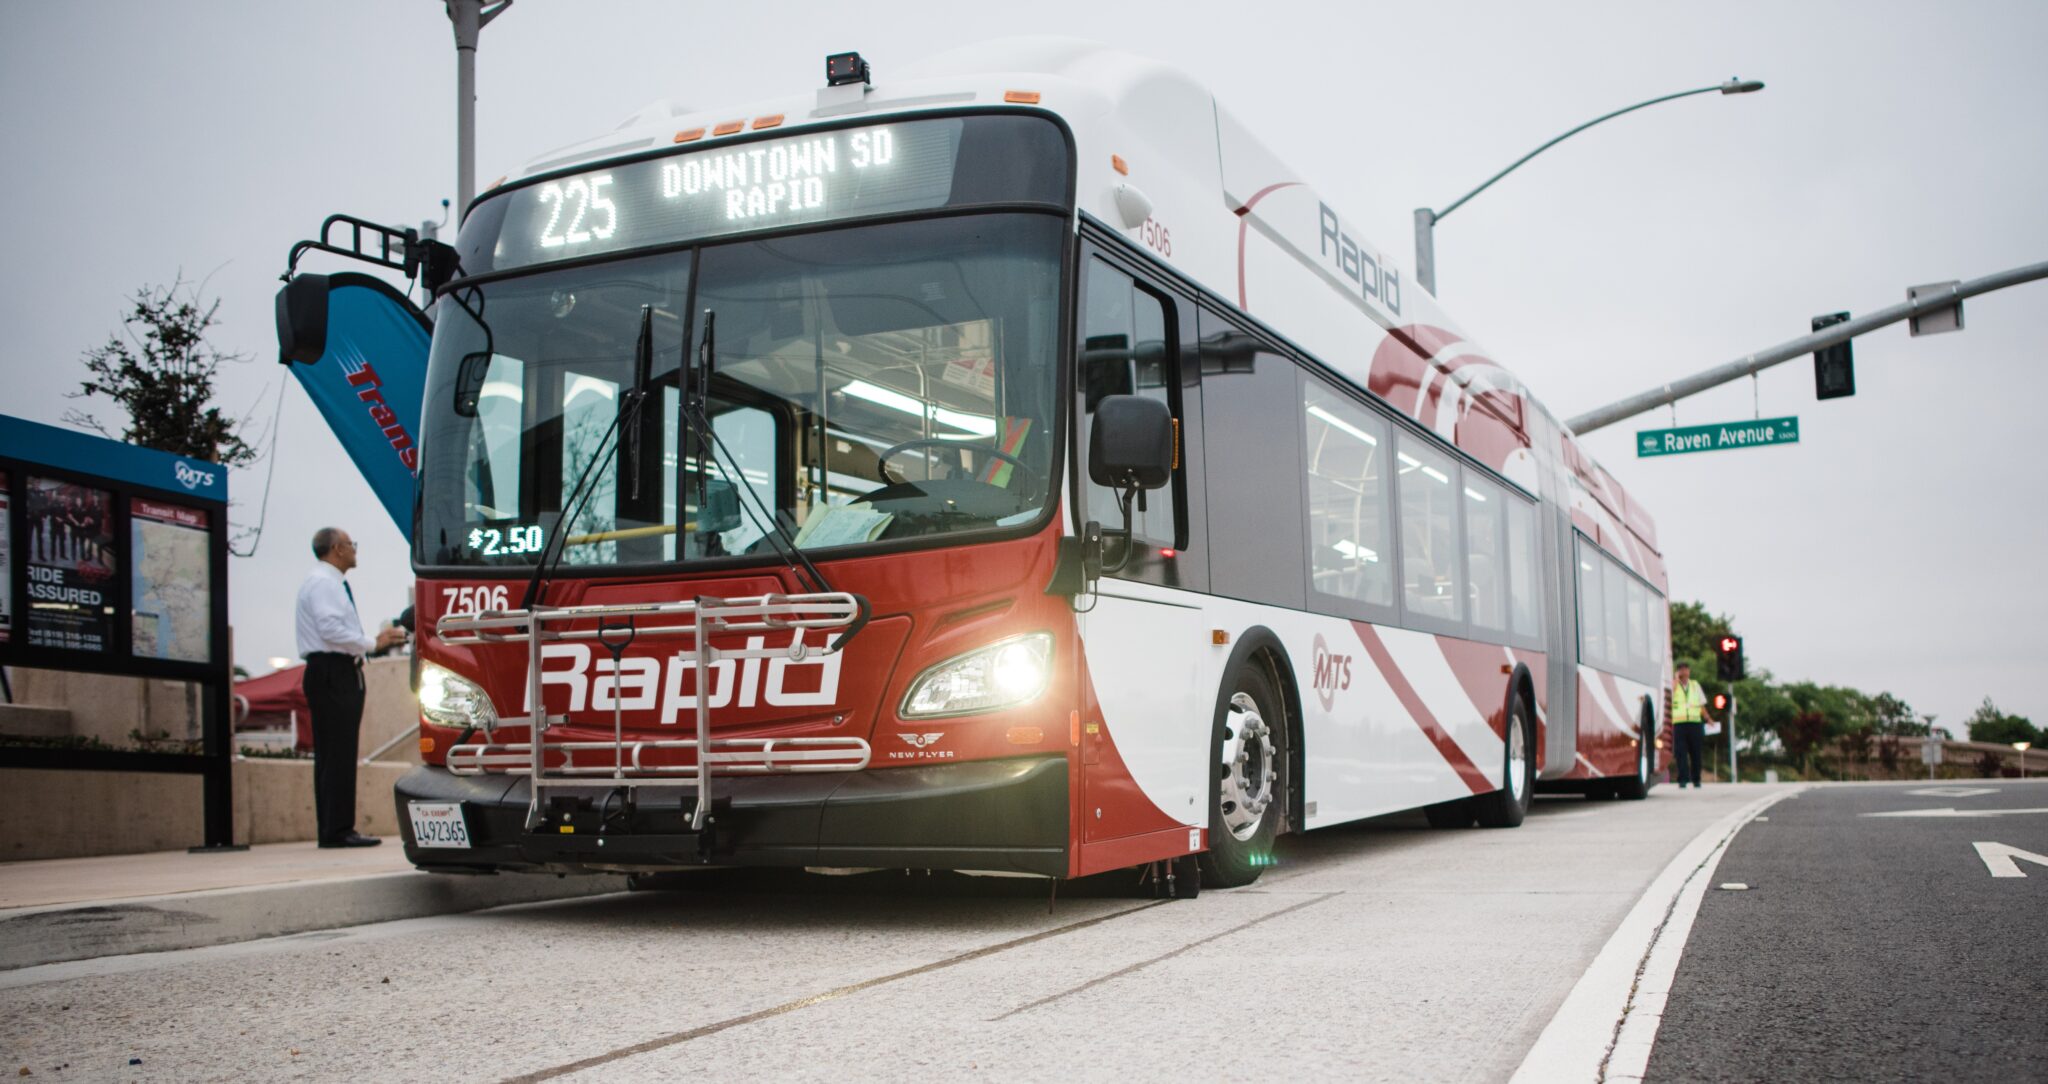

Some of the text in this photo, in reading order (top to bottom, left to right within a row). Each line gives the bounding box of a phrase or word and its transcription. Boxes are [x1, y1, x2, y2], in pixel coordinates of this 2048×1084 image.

[663, 129, 893, 198] DOWNTOWN SD
[540, 174, 616, 248] 225
[726, 177, 823, 220] RAPID
[1319, 200, 1401, 317] Rapid
[345, 361, 418, 478] Trans
[1664, 432, 1711, 452] Raven
[1718, 426, 1775, 446] Avenue
[176, 467, 215, 486] MTS
[468, 525, 543, 556] $2.50
[27, 565, 64, 584] RIDE
[27, 583, 102, 605] ASSURED
[443, 585, 509, 616] 7506
[523, 632, 844, 724] Rapid
[1313, 653, 1352, 690] MTS
[889, 751, 915, 759] NEW
[415, 821, 466, 841] 1492365
